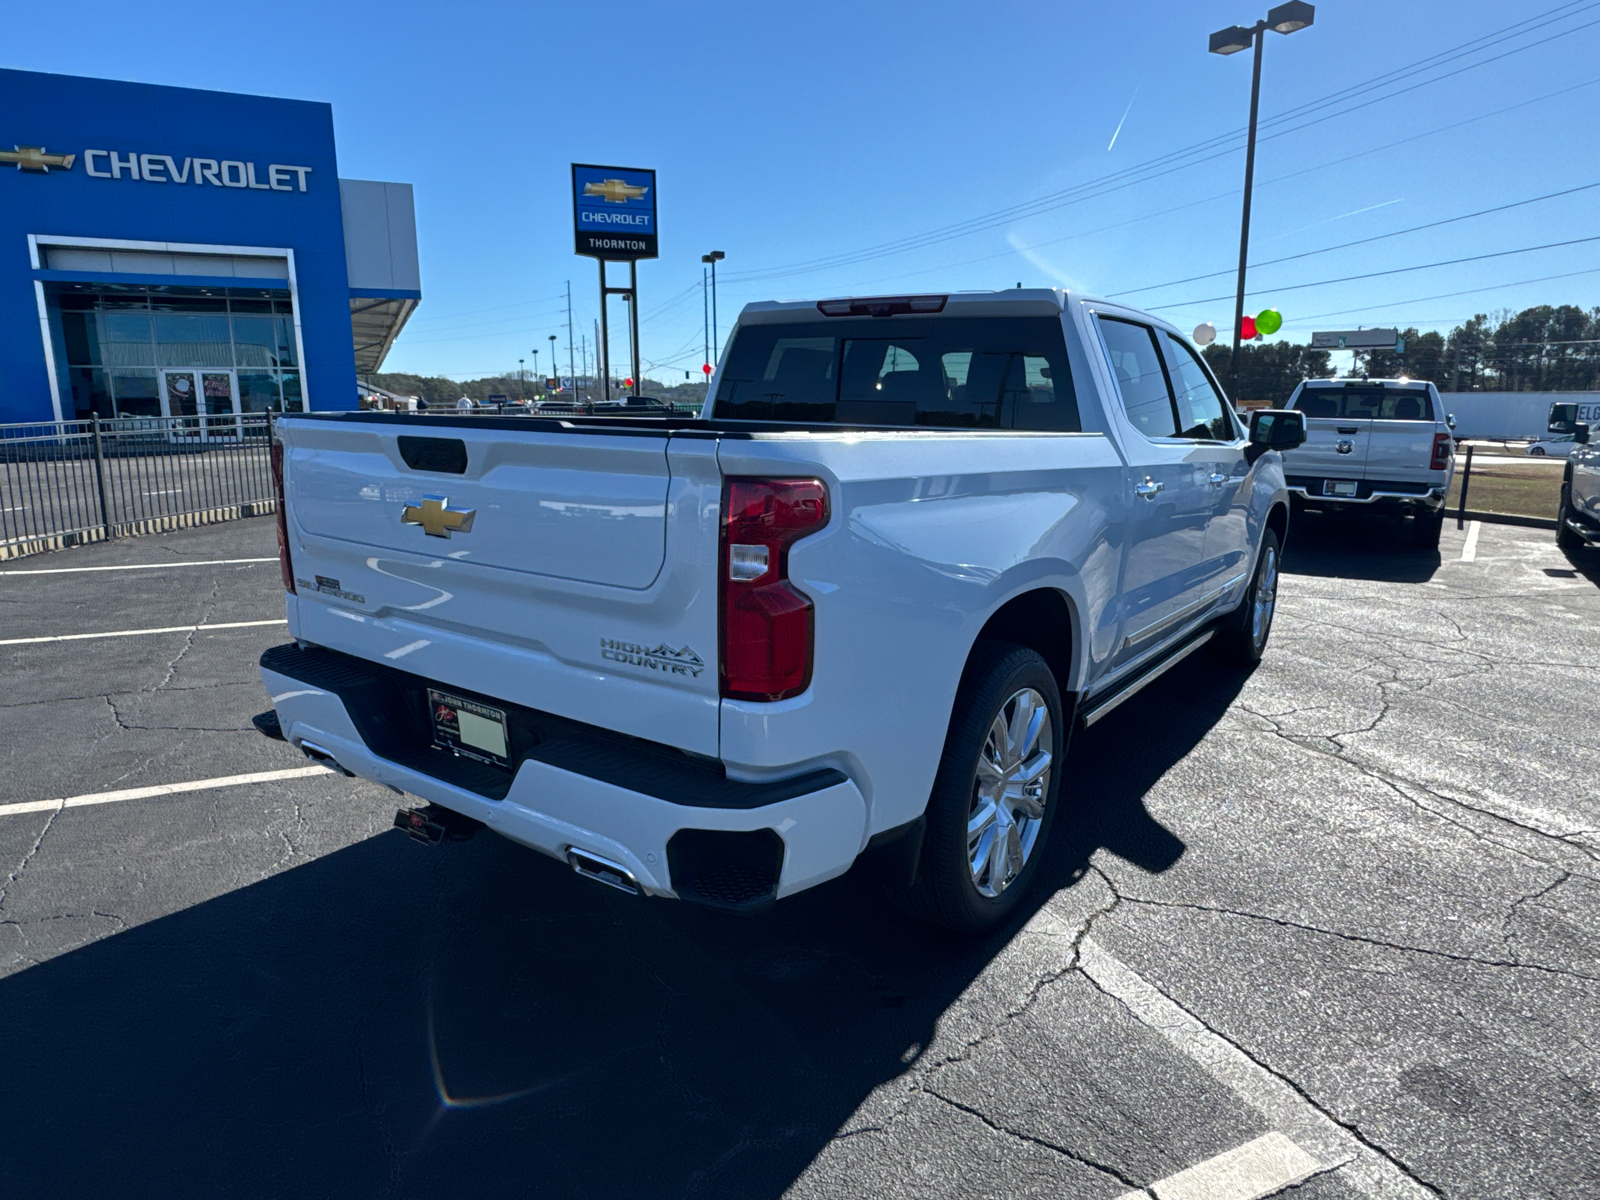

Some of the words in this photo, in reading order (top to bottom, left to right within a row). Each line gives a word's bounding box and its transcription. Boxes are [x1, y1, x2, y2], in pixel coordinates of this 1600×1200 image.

[84, 149, 312, 192] CHEVROLET
[582, 212, 650, 225] CHEVROLET
[589, 238, 646, 250] THORNTON
[600, 638, 650, 656] HIGH
[601, 649, 704, 678] COUNTRY
